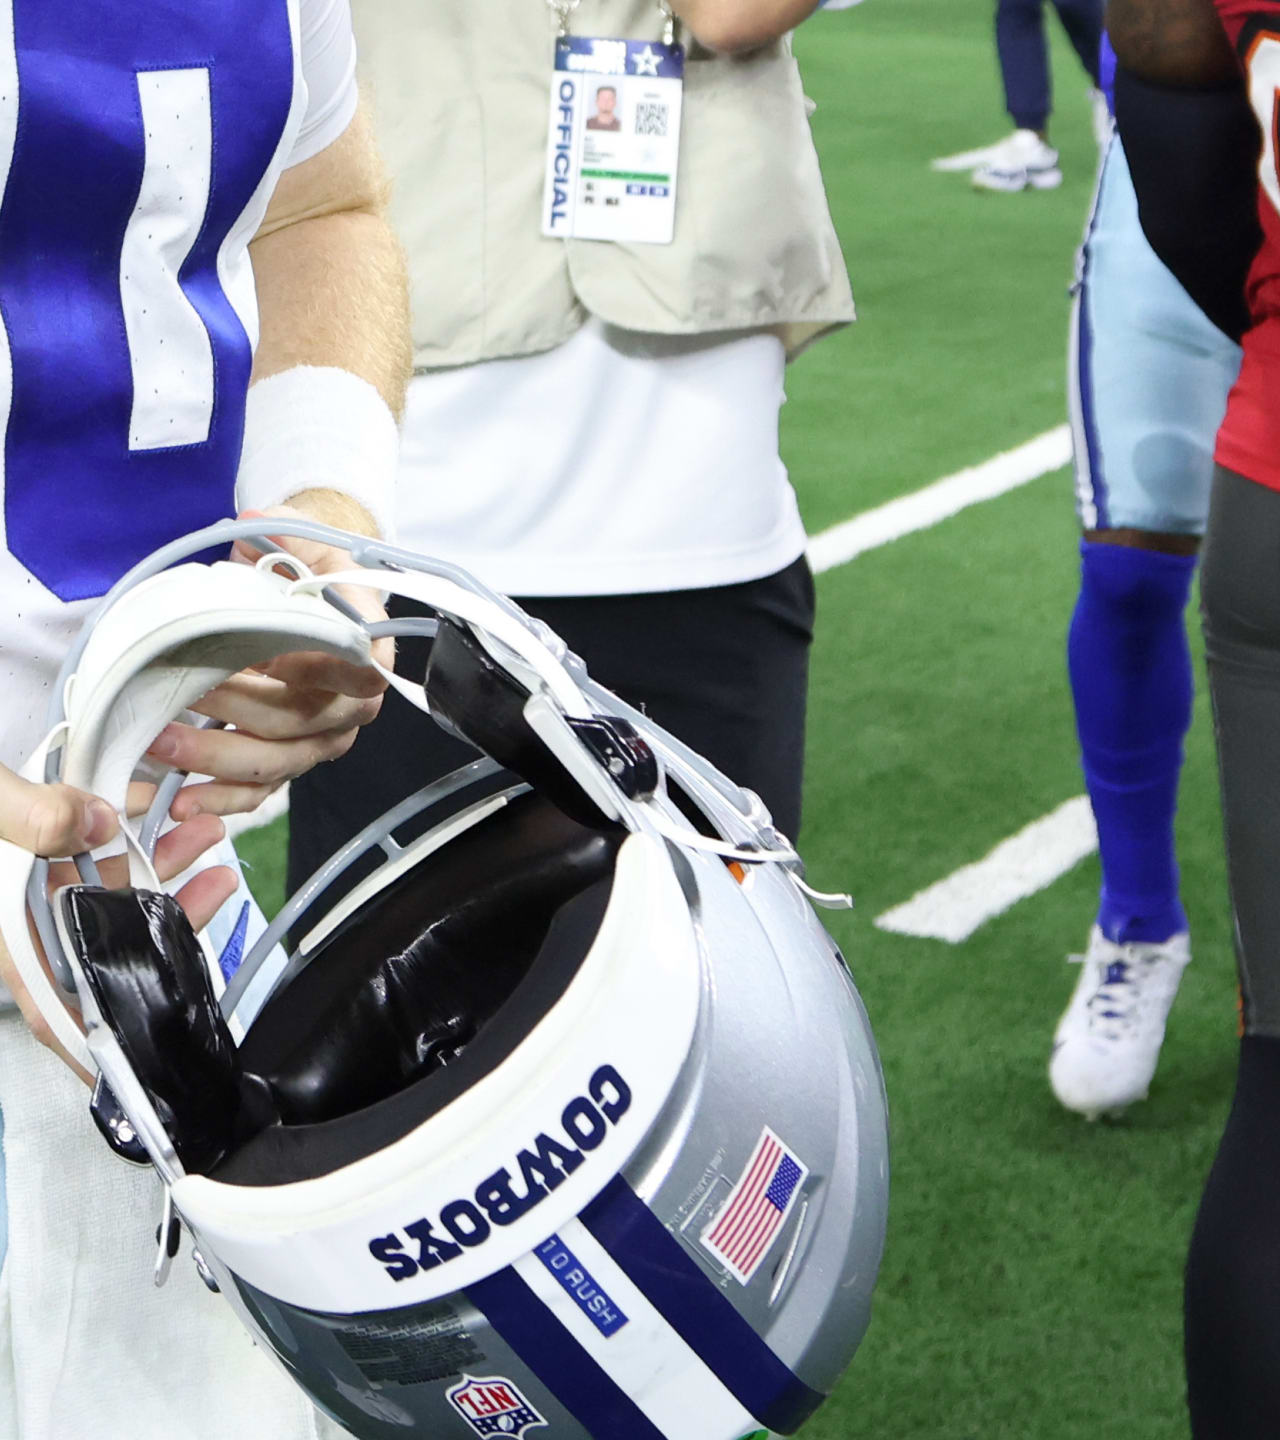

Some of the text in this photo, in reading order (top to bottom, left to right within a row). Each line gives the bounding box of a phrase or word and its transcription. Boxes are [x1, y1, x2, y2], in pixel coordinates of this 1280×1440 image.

[550, 79, 576, 229] OFFICIAL
[367, 1063, 632, 1283] COWBOYS
[564, 1268, 618, 1327] RUSH
[456, 1385, 520, 1417] NFL
